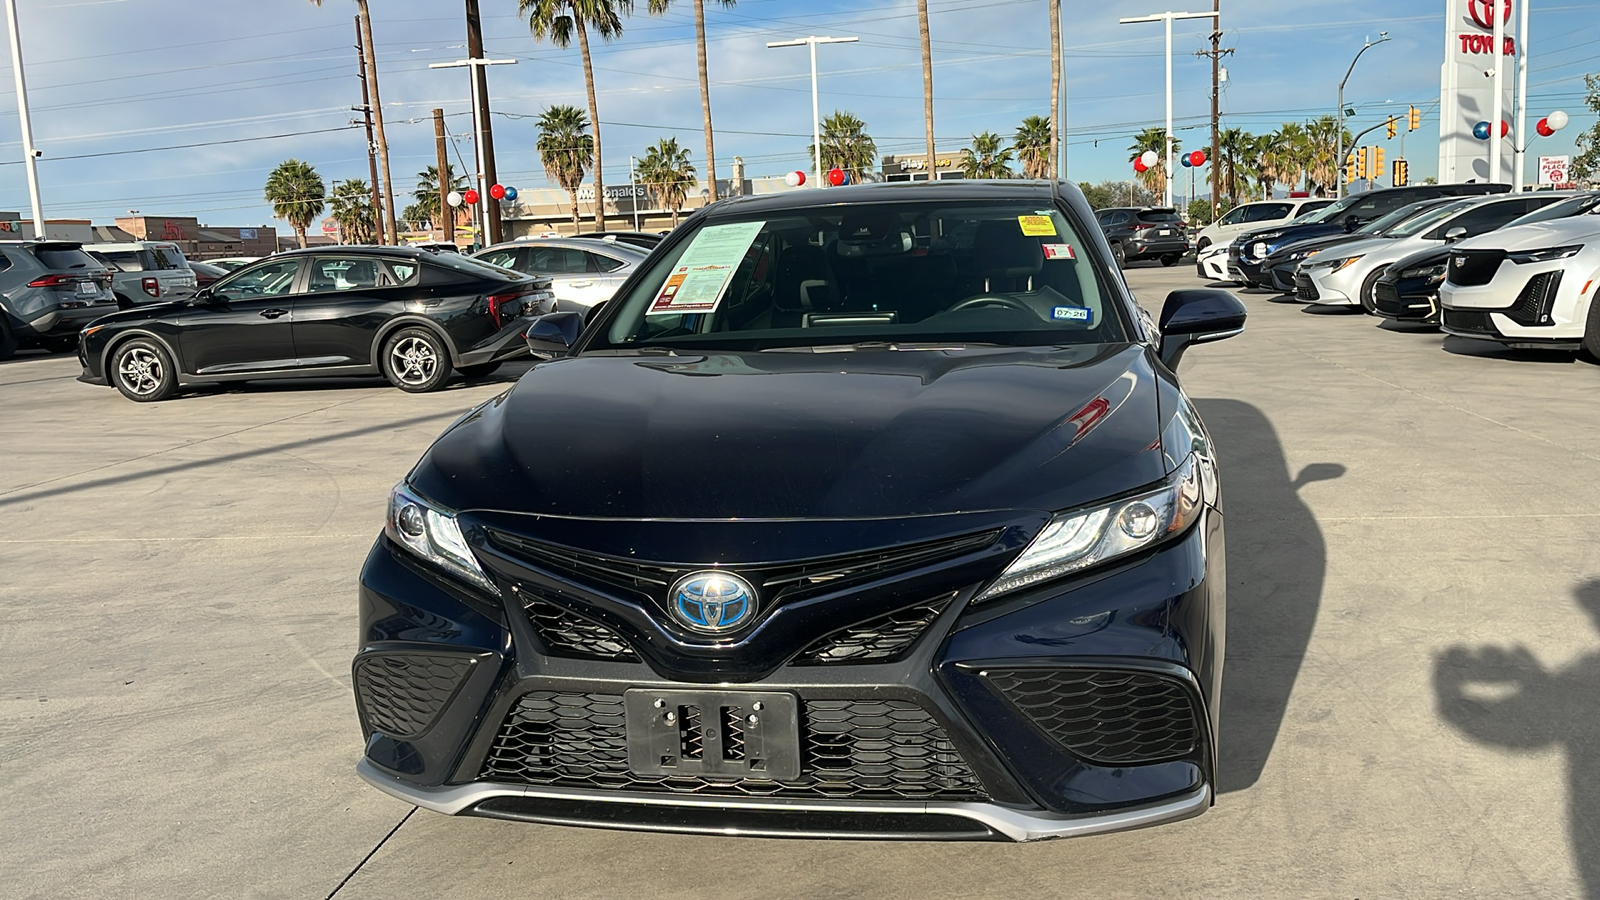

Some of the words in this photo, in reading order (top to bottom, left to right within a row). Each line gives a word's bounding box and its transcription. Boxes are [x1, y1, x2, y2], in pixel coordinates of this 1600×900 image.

[1459, 34, 1515, 55] TOYA
[900, 158, 951, 171] playpce
[578, 187, 645, 199] Mconald's
[1056, 309, 1086, 318] 07-26
